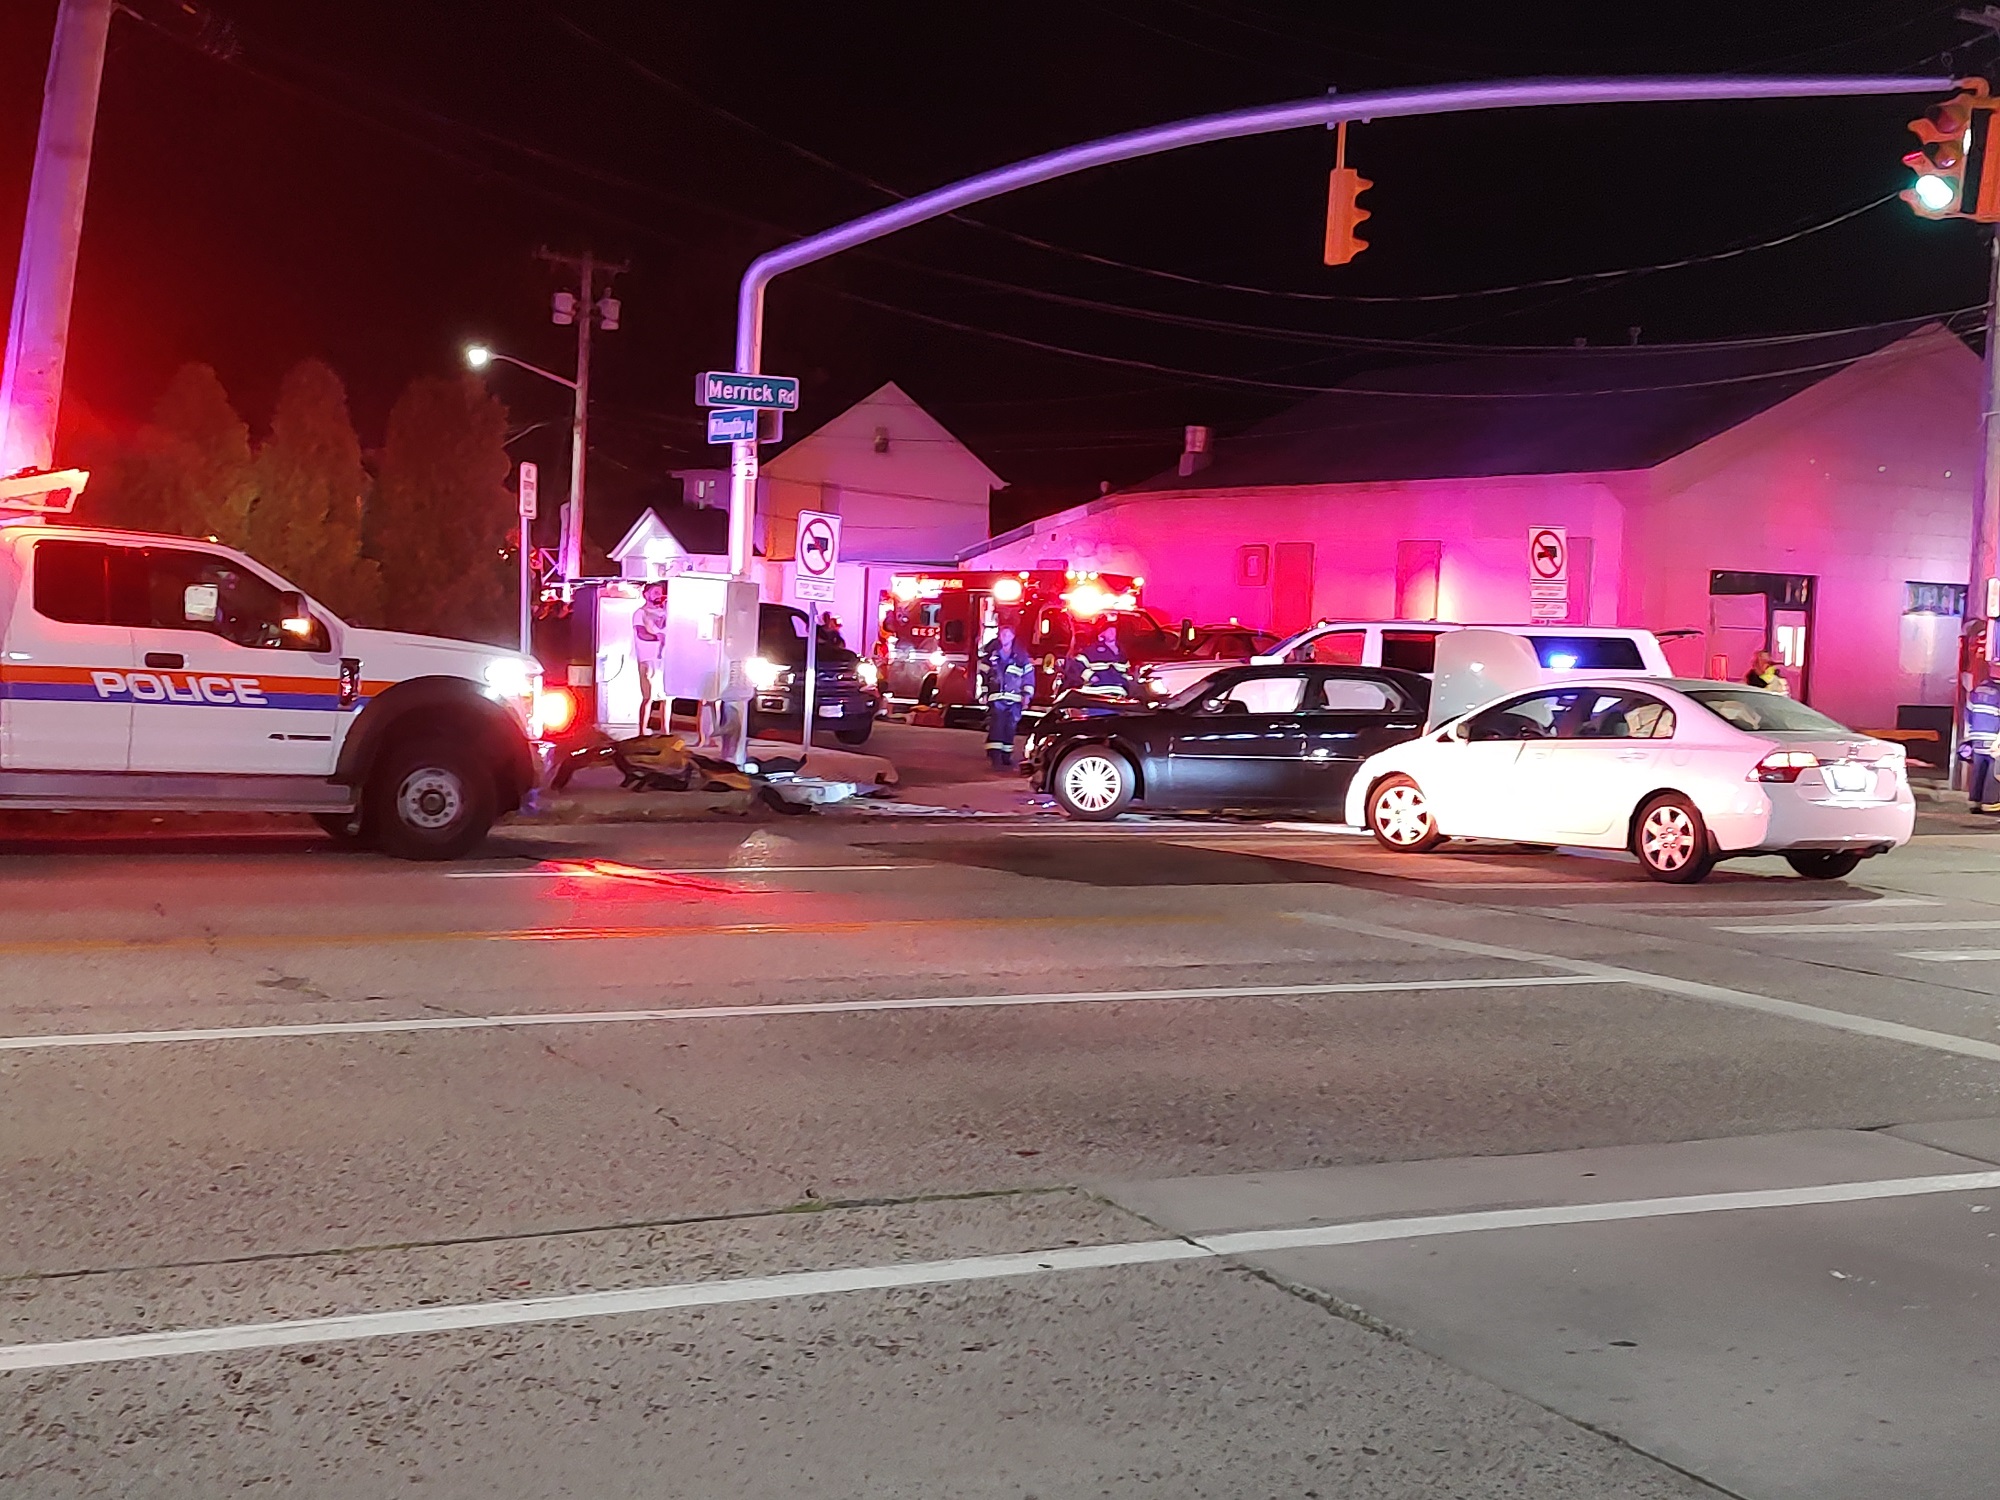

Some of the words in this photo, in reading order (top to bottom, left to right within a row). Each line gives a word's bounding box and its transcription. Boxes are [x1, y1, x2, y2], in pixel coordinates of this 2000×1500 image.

[709, 379, 774, 403] Merrick
[778, 387, 795, 404] Rd
[90, 671, 269, 705] POLICE
